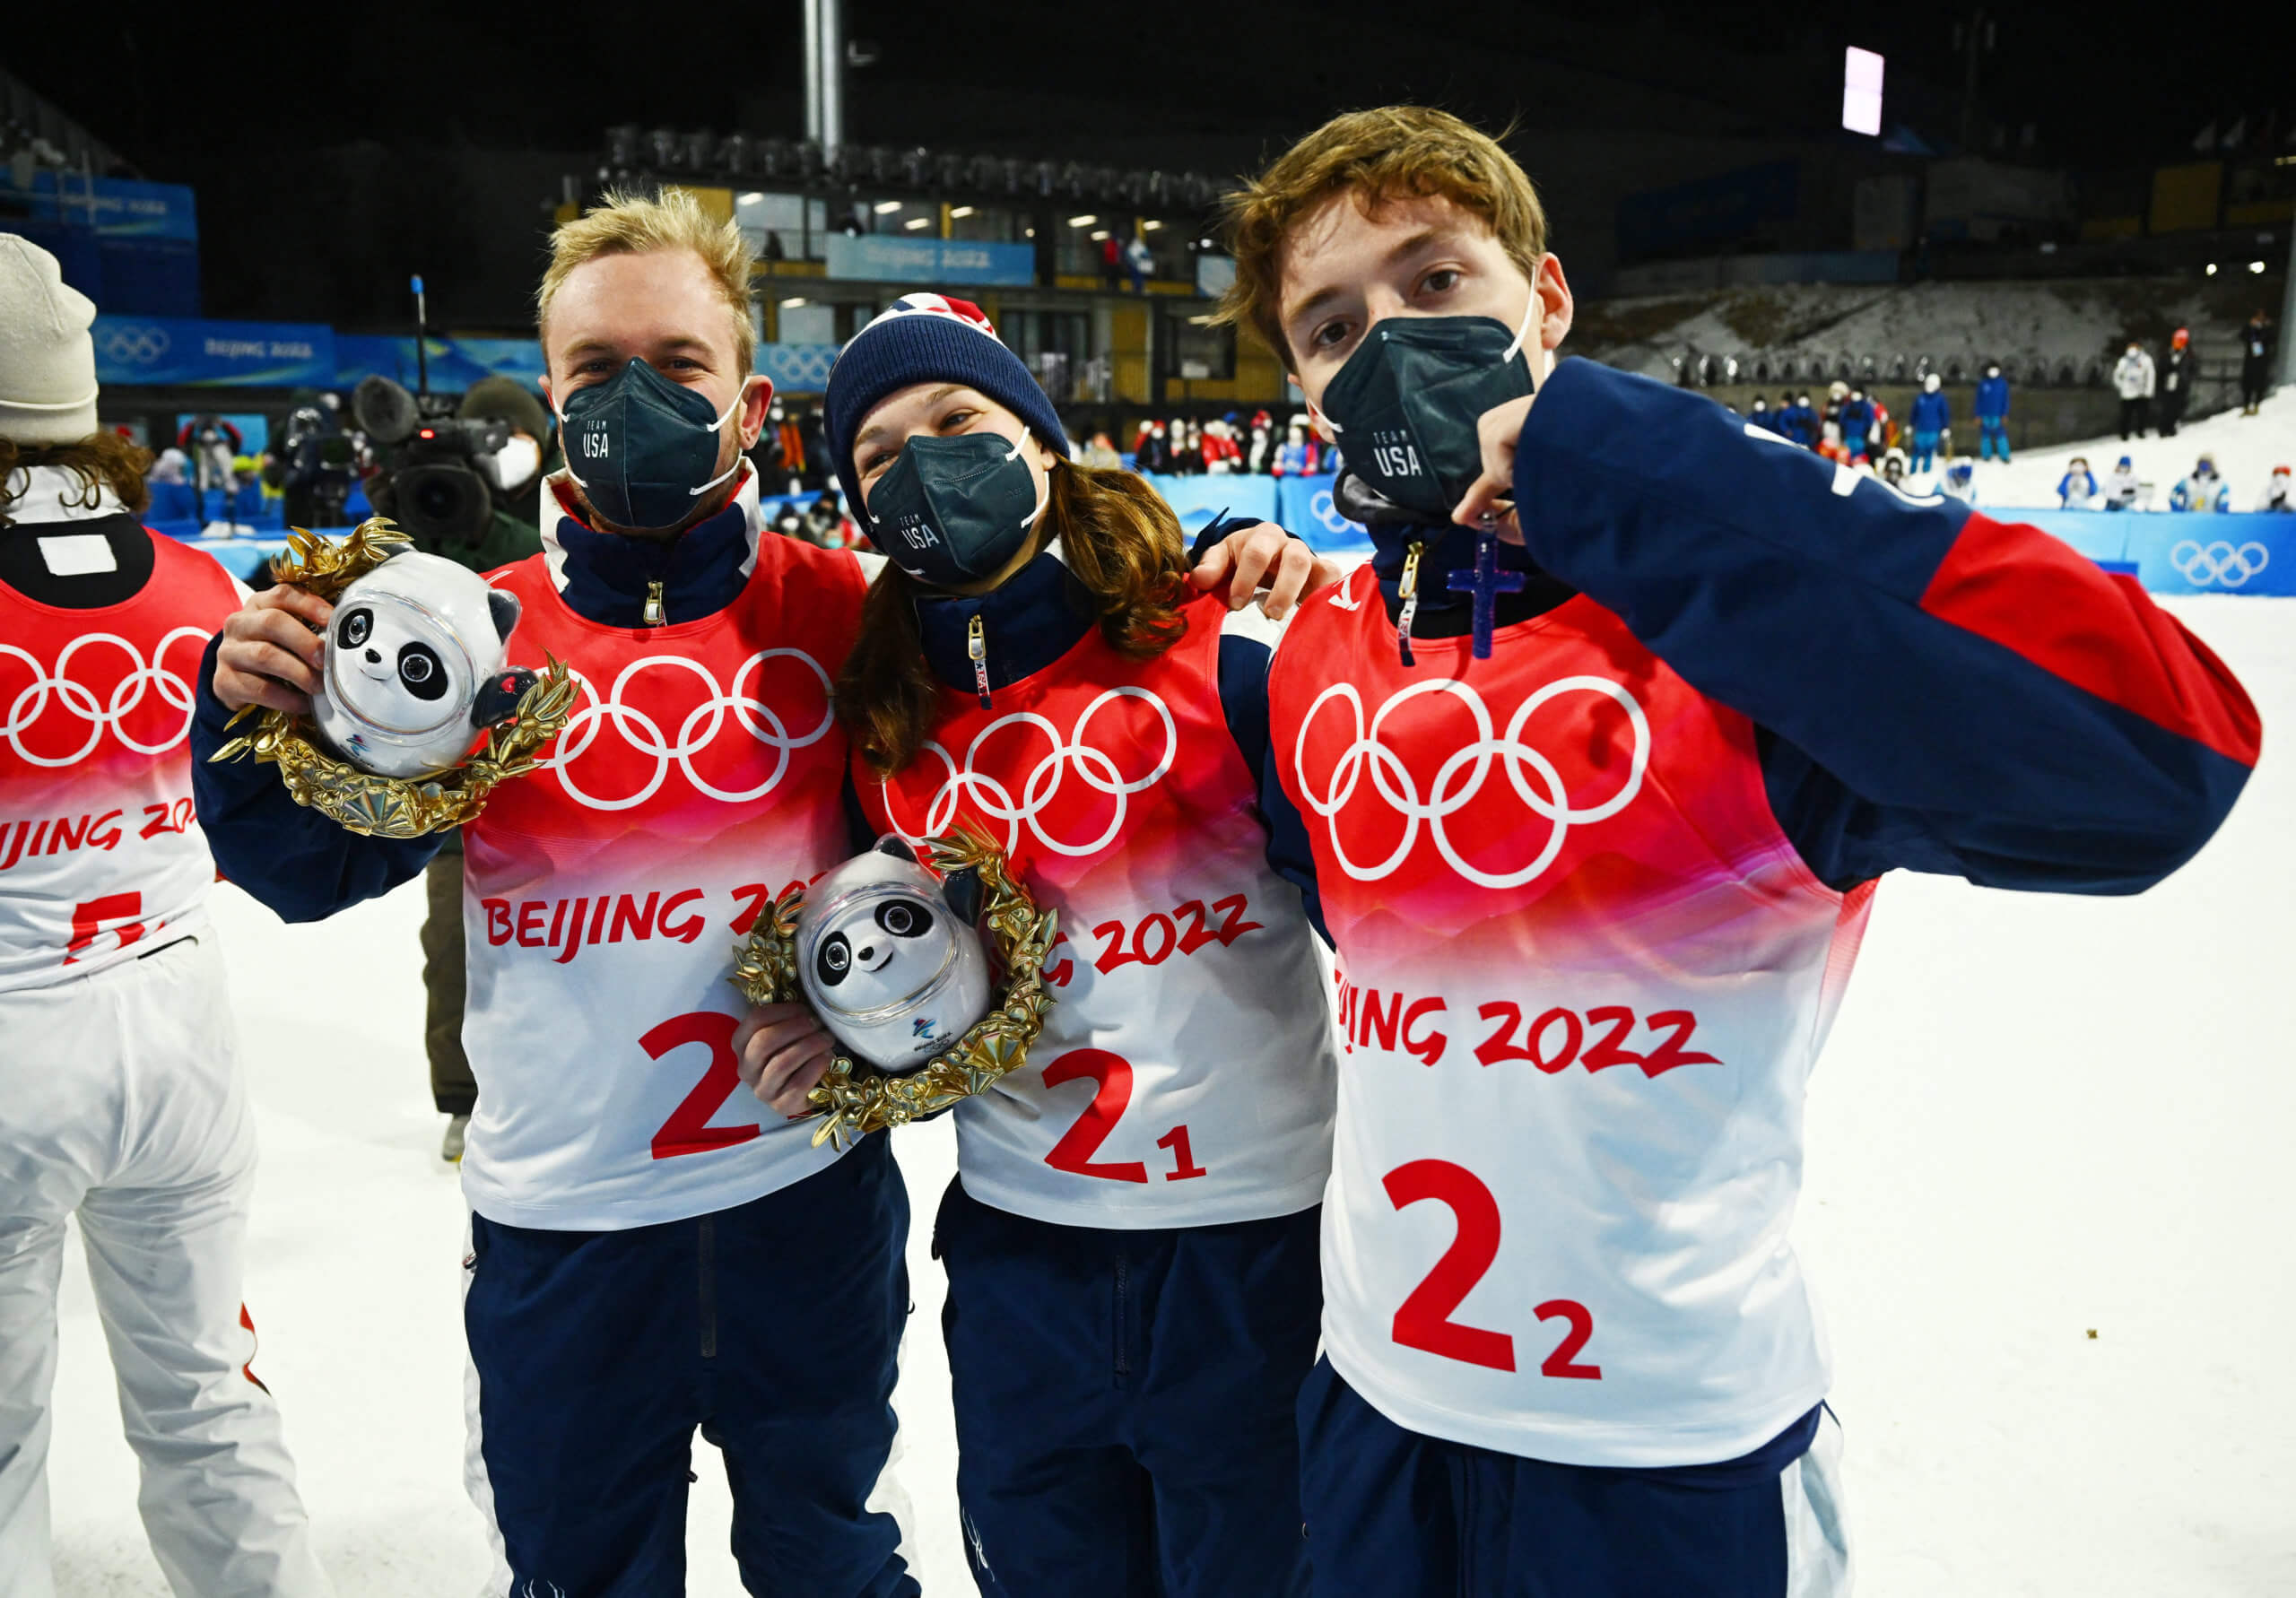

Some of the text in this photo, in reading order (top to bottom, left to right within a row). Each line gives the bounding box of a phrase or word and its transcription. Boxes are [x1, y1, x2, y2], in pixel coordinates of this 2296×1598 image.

[583, 433, 609, 458] USA
[587, 420, 607, 430] TEAM
[1372, 430, 1408, 445] TEAM
[1373, 445, 1422, 477] USA
[899, 513, 922, 527] TEAM
[900, 524, 940, 550] USA
[139, 796, 197, 841] 20
[481, 888, 705, 964] BEIJING
[1091, 893, 1265, 976] 2022
[1473, 1001, 1725, 1080] 2022
[638, 1011, 761, 1160] 2
[1041, 1047, 1206, 1184] 2 1
[1381, 1159, 1603, 1381] 2 2
